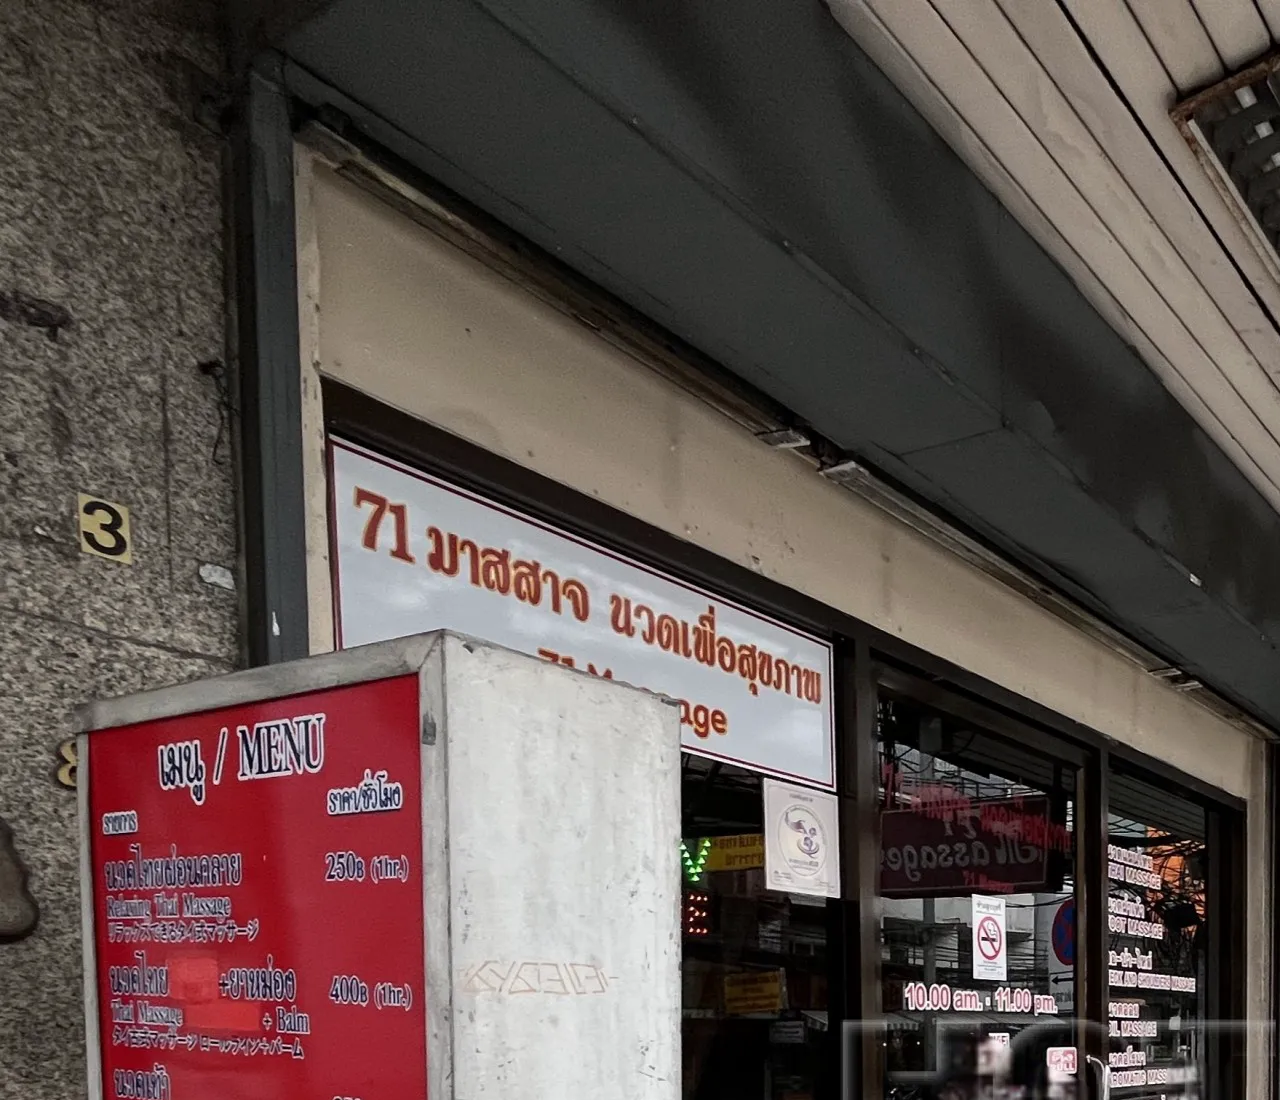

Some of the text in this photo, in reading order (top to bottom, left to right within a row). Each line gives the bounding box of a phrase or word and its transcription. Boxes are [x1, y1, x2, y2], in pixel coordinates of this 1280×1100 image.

[83, 501, 127, 555] 3
[354, 485, 415, 564] 71
[425, 523, 589, 623] มาสสาจ
[609, 593, 822, 705] นวดเพื่อสุขภาพ
[158, 713, 325, 806] เมนู / MENU
[1126, 867, 1161, 890] MASSAGE
[154, 892, 179, 918] Thai
[182, 893, 231, 922] Massage
[1108, 914, 1163, 940] OOT MASSAGE
[109, 951, 170, 998] นวดไทย
[1109, 969, 1124, 986] ECK
[905, 983, 951, 1012] 10.00
[953, 990, 983, 1012] am.
[994, 988, 1032, 1013] 11.00
[1034, 992, 1059, 1016] pm.
[111, 1000, 135, 1024] Thai
[137, 1002, 184, 1031] Massage
[276, 1006, 310, 1034] Balm
[1121, 1020, 1157, 1037] MASSAGE
